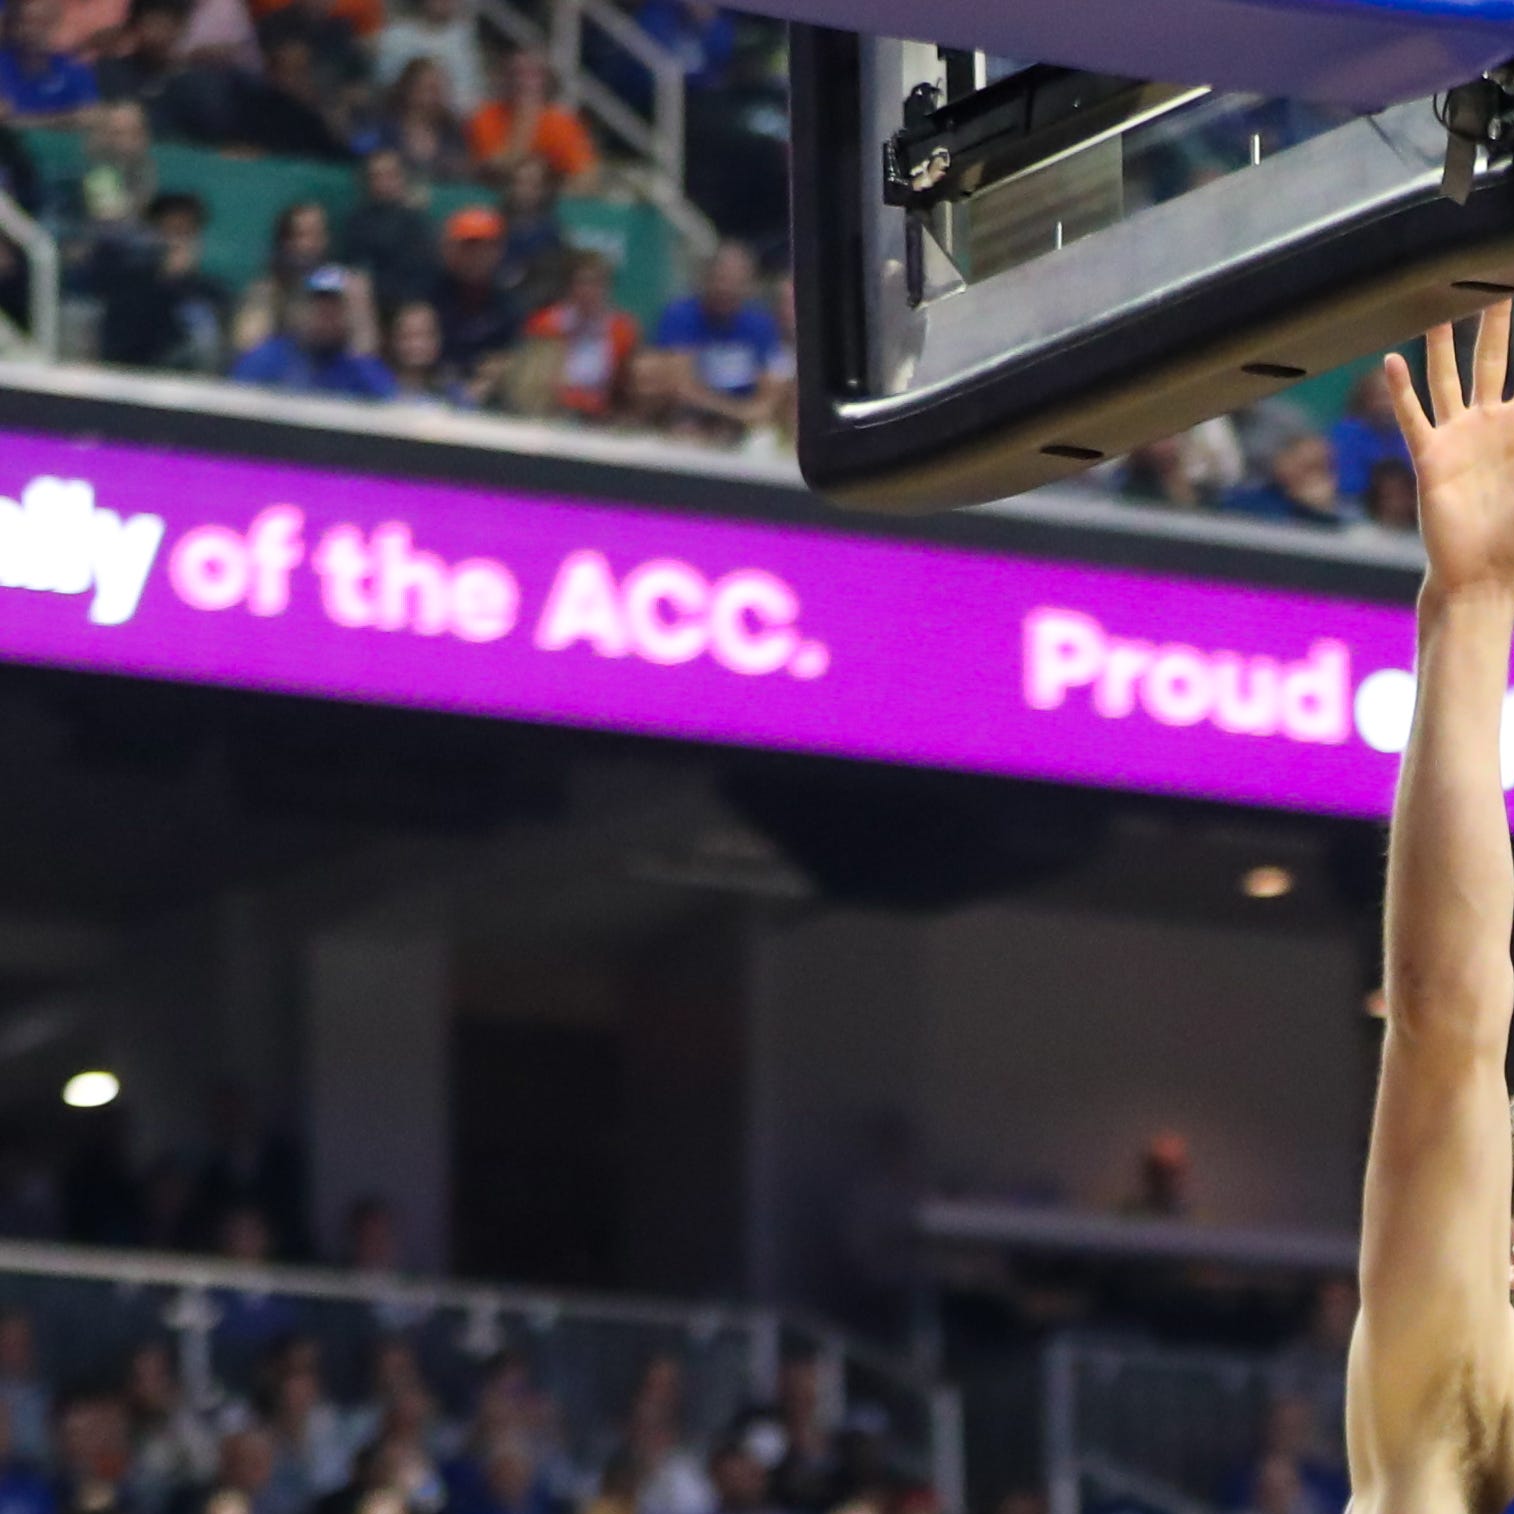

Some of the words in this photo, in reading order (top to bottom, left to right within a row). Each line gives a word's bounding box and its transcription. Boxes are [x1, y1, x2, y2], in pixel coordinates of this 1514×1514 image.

[169, 504, 305, 616] of
[313, 521, 520, 643] the
[534, 550, 831, 679] ACC.
[1023, 606, 1350, 745] Proud
